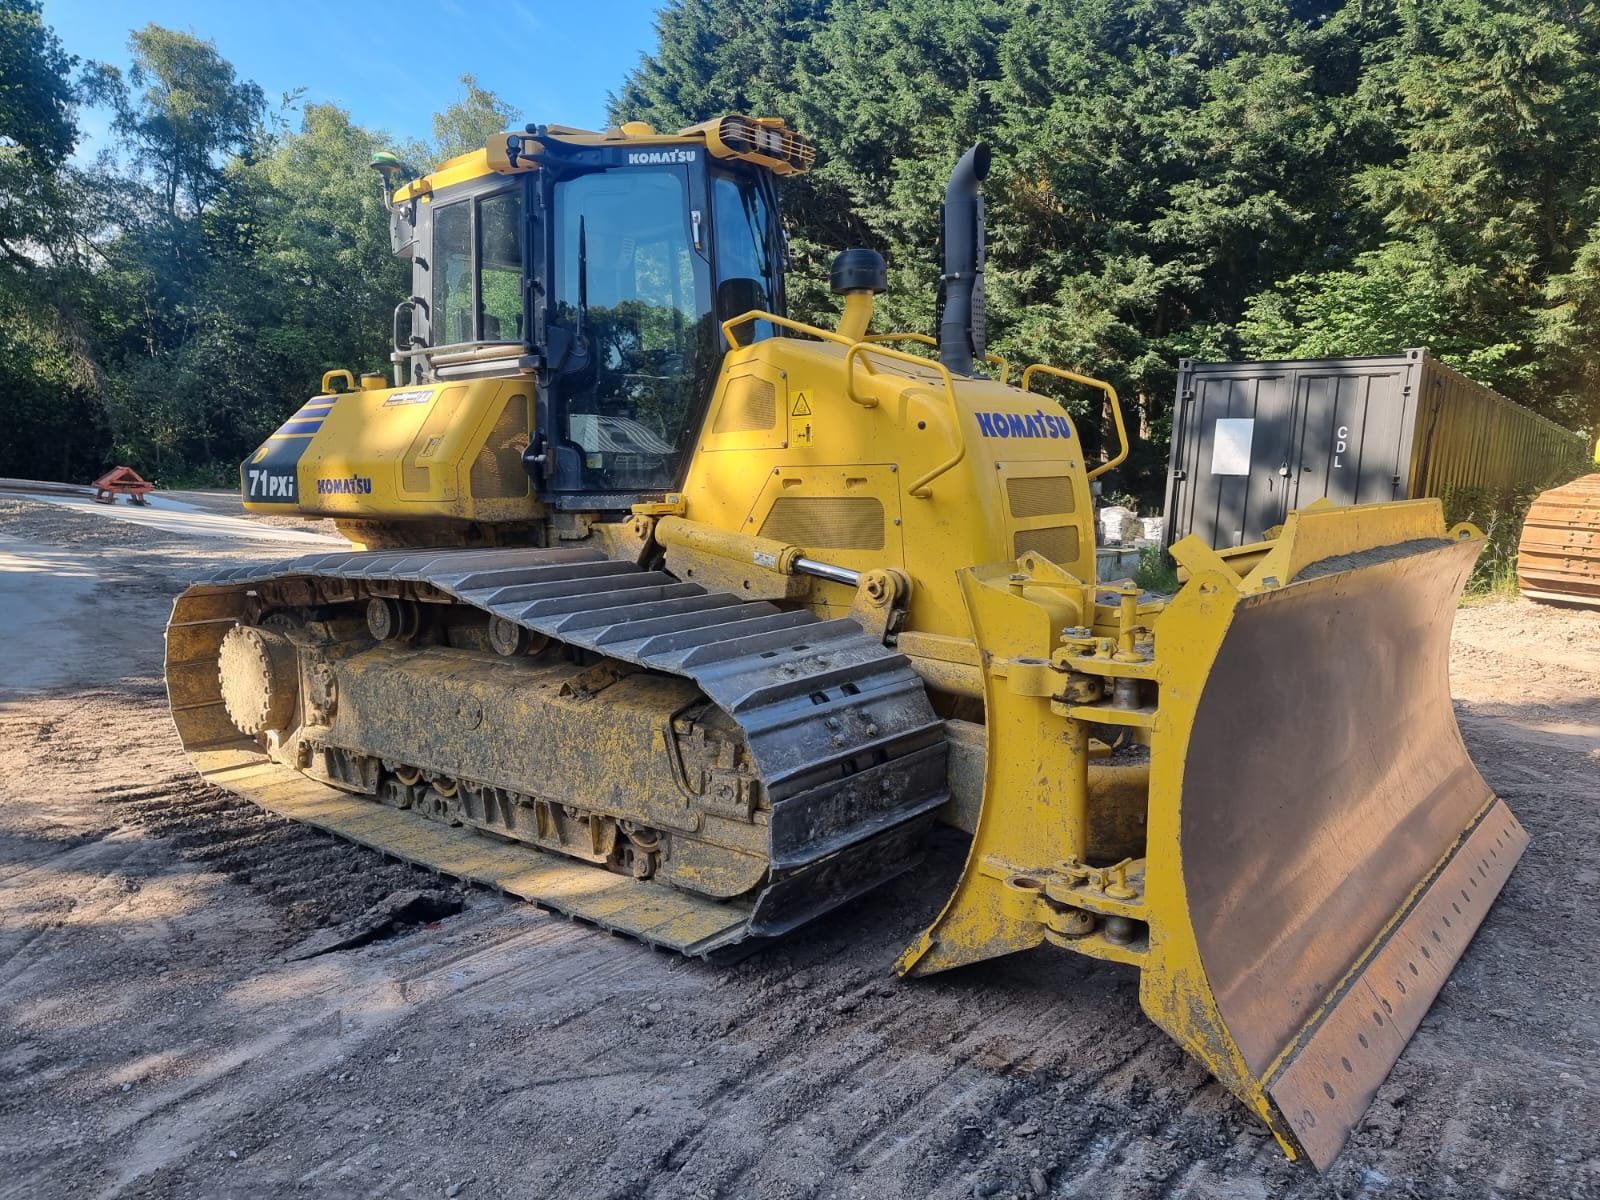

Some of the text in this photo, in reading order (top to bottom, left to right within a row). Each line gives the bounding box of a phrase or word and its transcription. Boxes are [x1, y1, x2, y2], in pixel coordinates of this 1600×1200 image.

[629, 149, 696, 164] KOMATSU
[975, 409, 1071, 439] KOMATSU
[317, 474, 372, 494] KOMATSU
